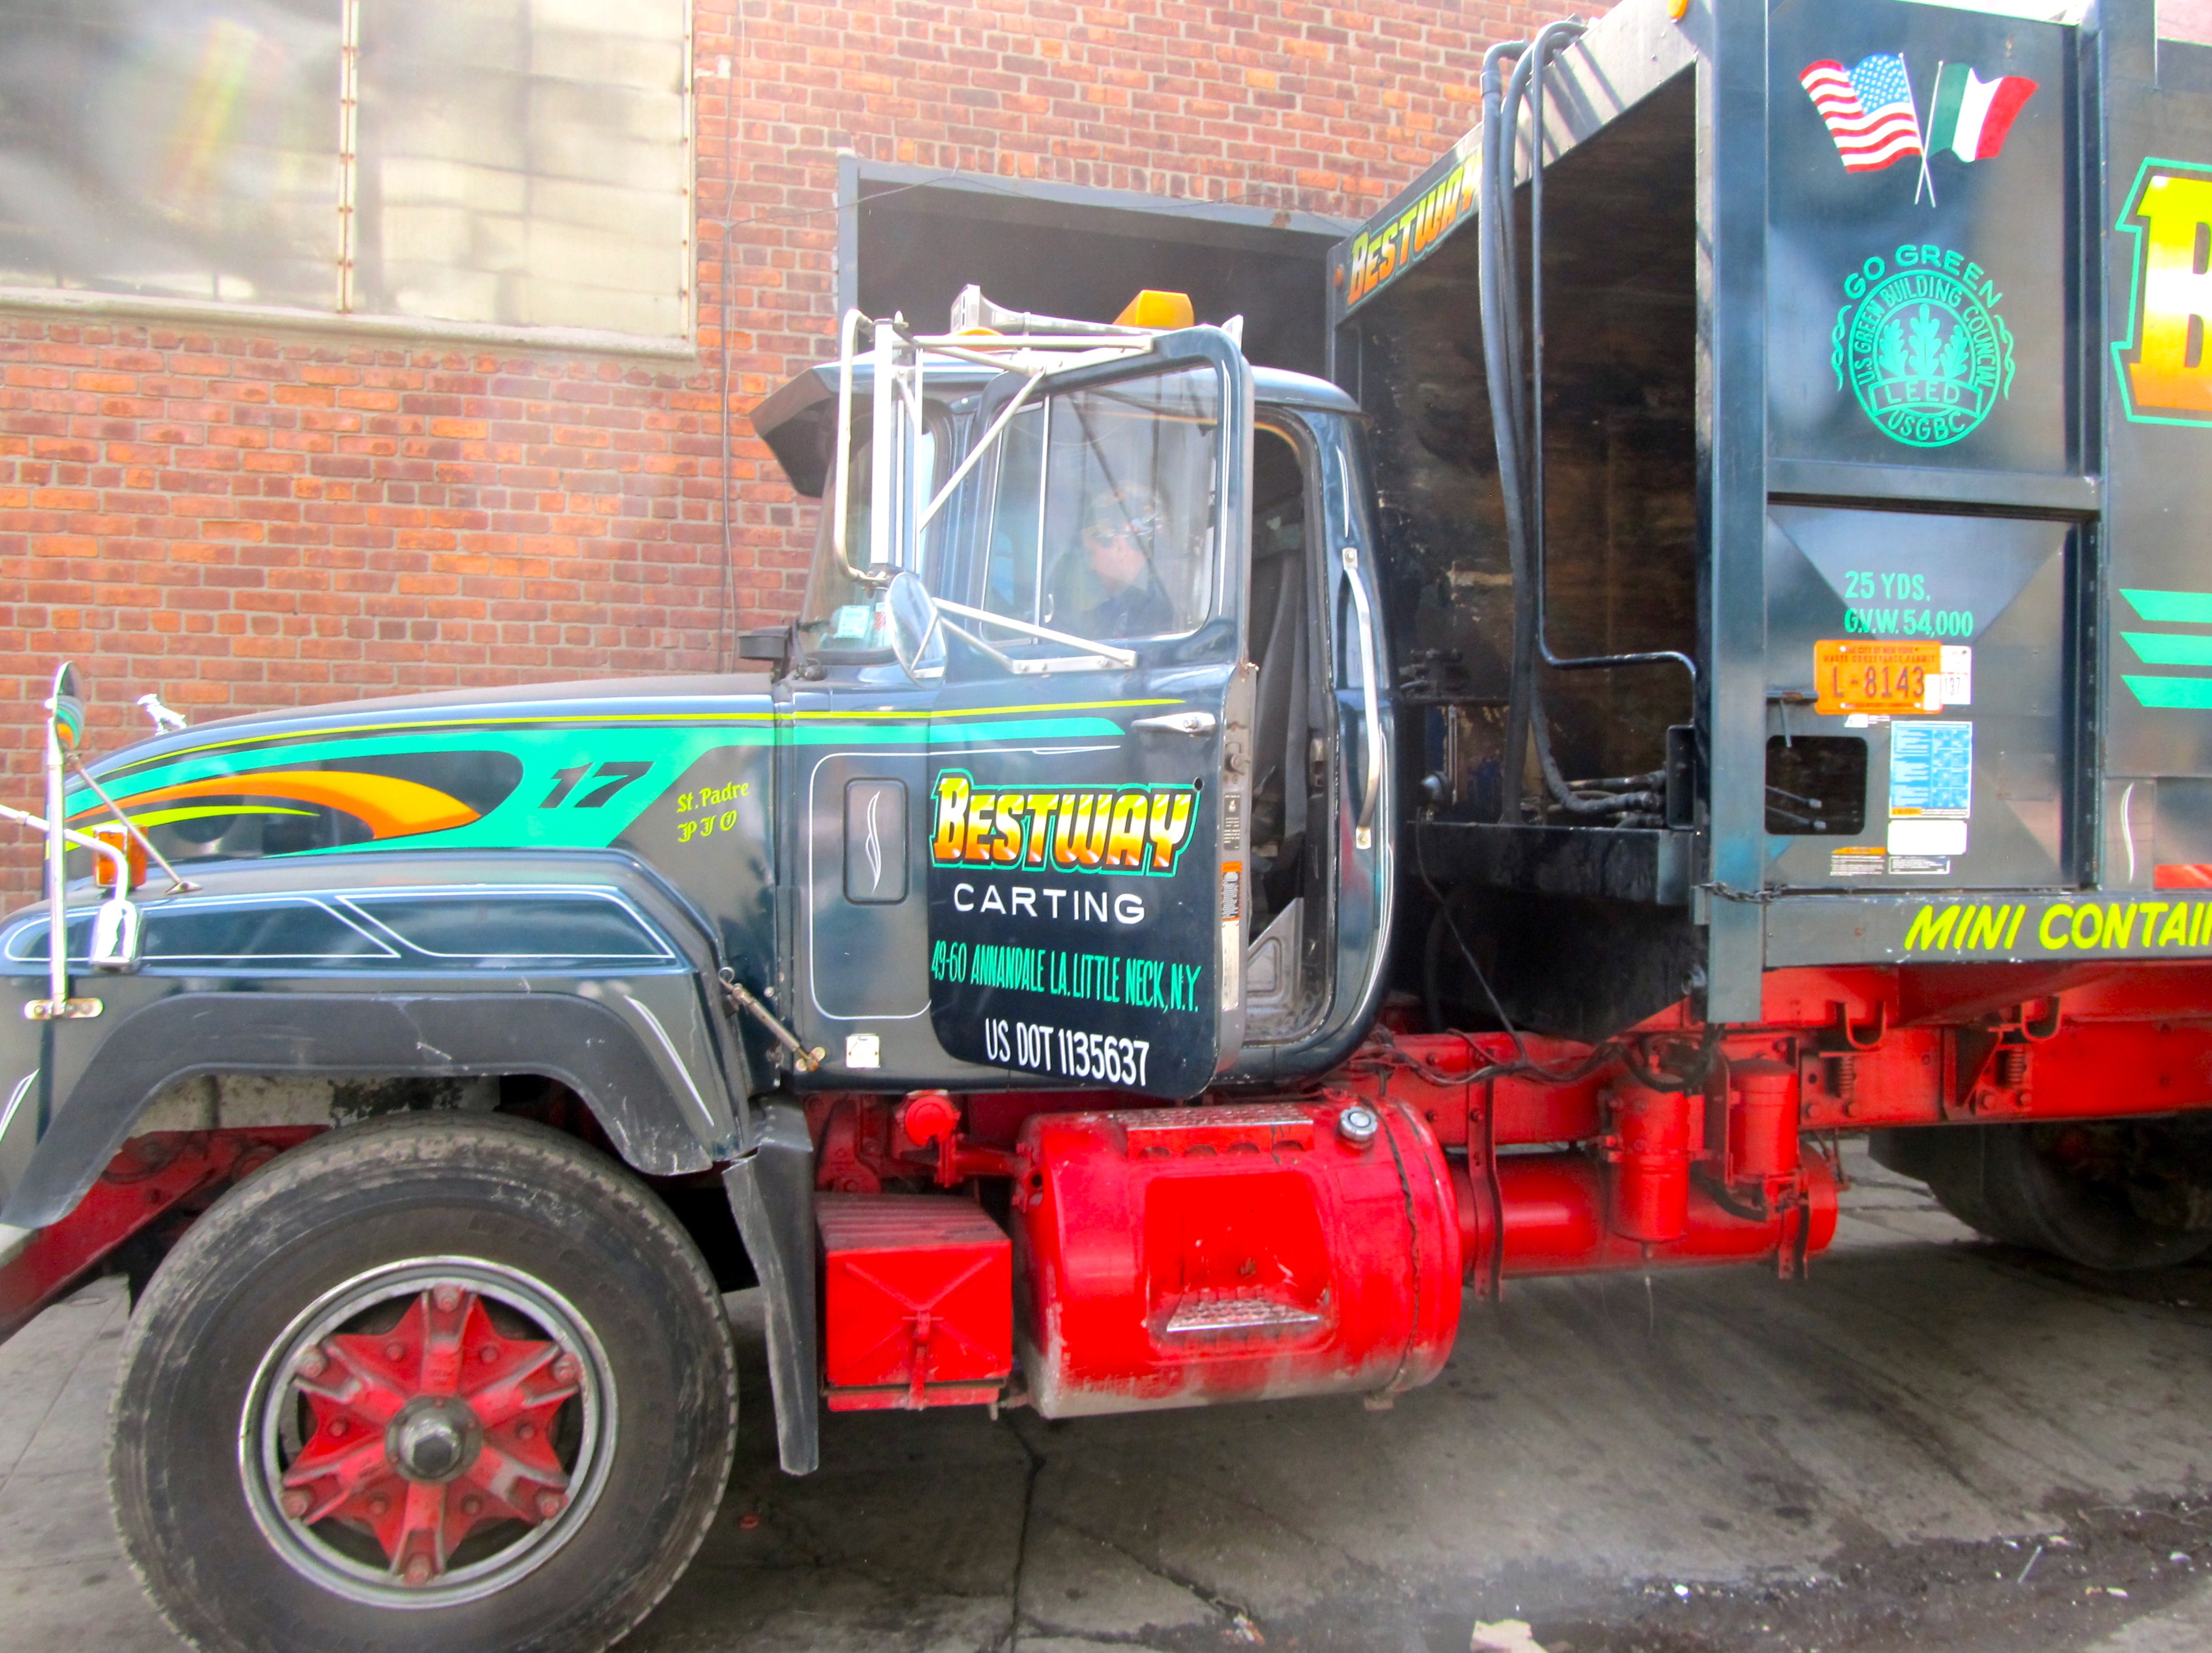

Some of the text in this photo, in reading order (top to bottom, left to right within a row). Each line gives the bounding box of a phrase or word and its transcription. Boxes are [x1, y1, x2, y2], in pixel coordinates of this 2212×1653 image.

[1844, 244, 2003, 308] GO GREEN
[1854, 300, 1886, 354] GREEN
[1879, 274, 1962, 307] BUILDING
[1884, 379, 1961, 404] LEED
[1887, 409, 1966, 441] USGBC
[1844, 570, 1931, 602] 25 YDS.
[1903, 609, 1974, 638] 54,000
[538, 760, 655, 809] 17
[676, 781, 750, 813] St. Padre
[933, 774, 1194, 871] BESTWAY
[953, 883, 1145, 925] CARTING
[1904, 904, 2027, 951] MINI
[930, 939, 967, 983] 49-60
[970, 944, 1046, 993] ANNANDALE
[1073, 953, 1121, 1003] LITTLE
[1170, 963, 1202, 1013] N.Y.
[985, 1017, 1150, 1087] US DOT 1135637
